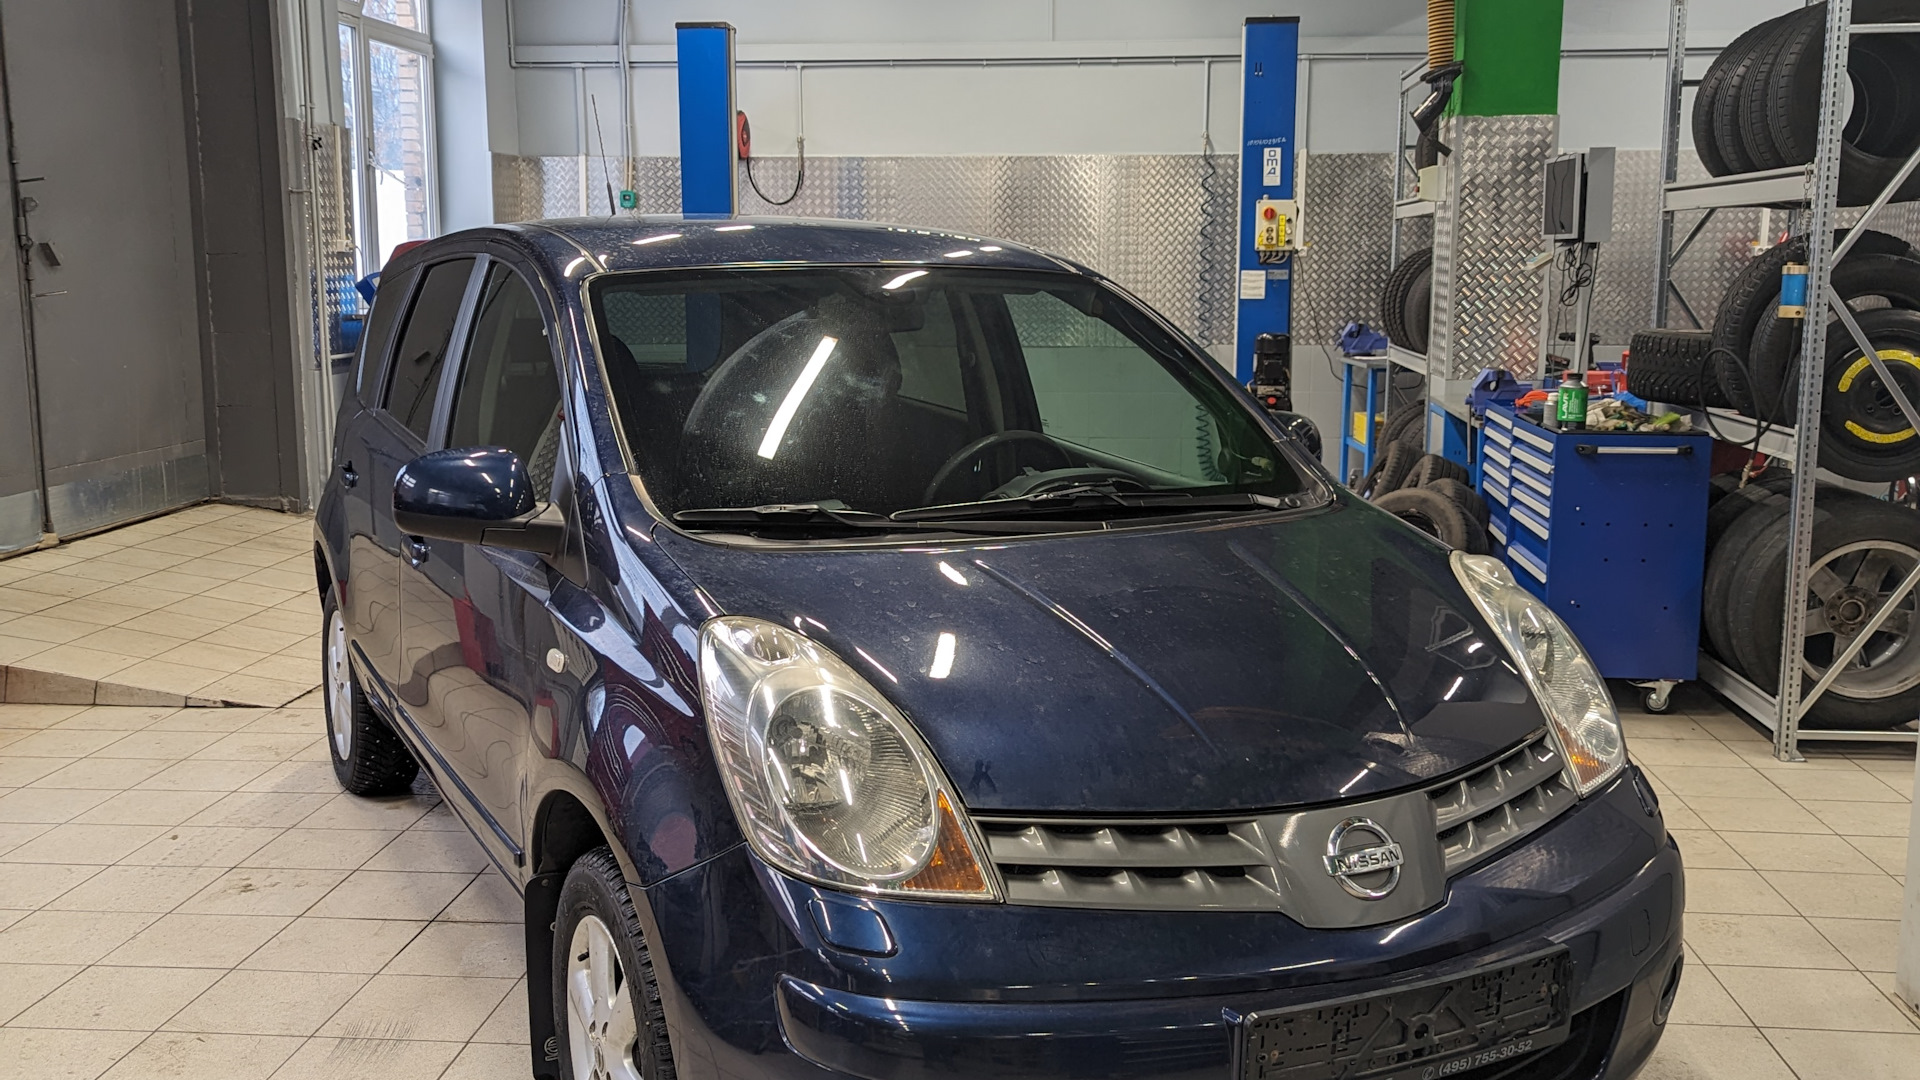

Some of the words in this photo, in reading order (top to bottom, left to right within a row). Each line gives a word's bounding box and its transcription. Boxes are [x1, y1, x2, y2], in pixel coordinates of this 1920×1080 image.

[1337, 848, 1400, 872] NISSAN
[1439, 1057, 1471, 1077] (495)
[1475, 1040, 1533, 1066] 755-30-52
